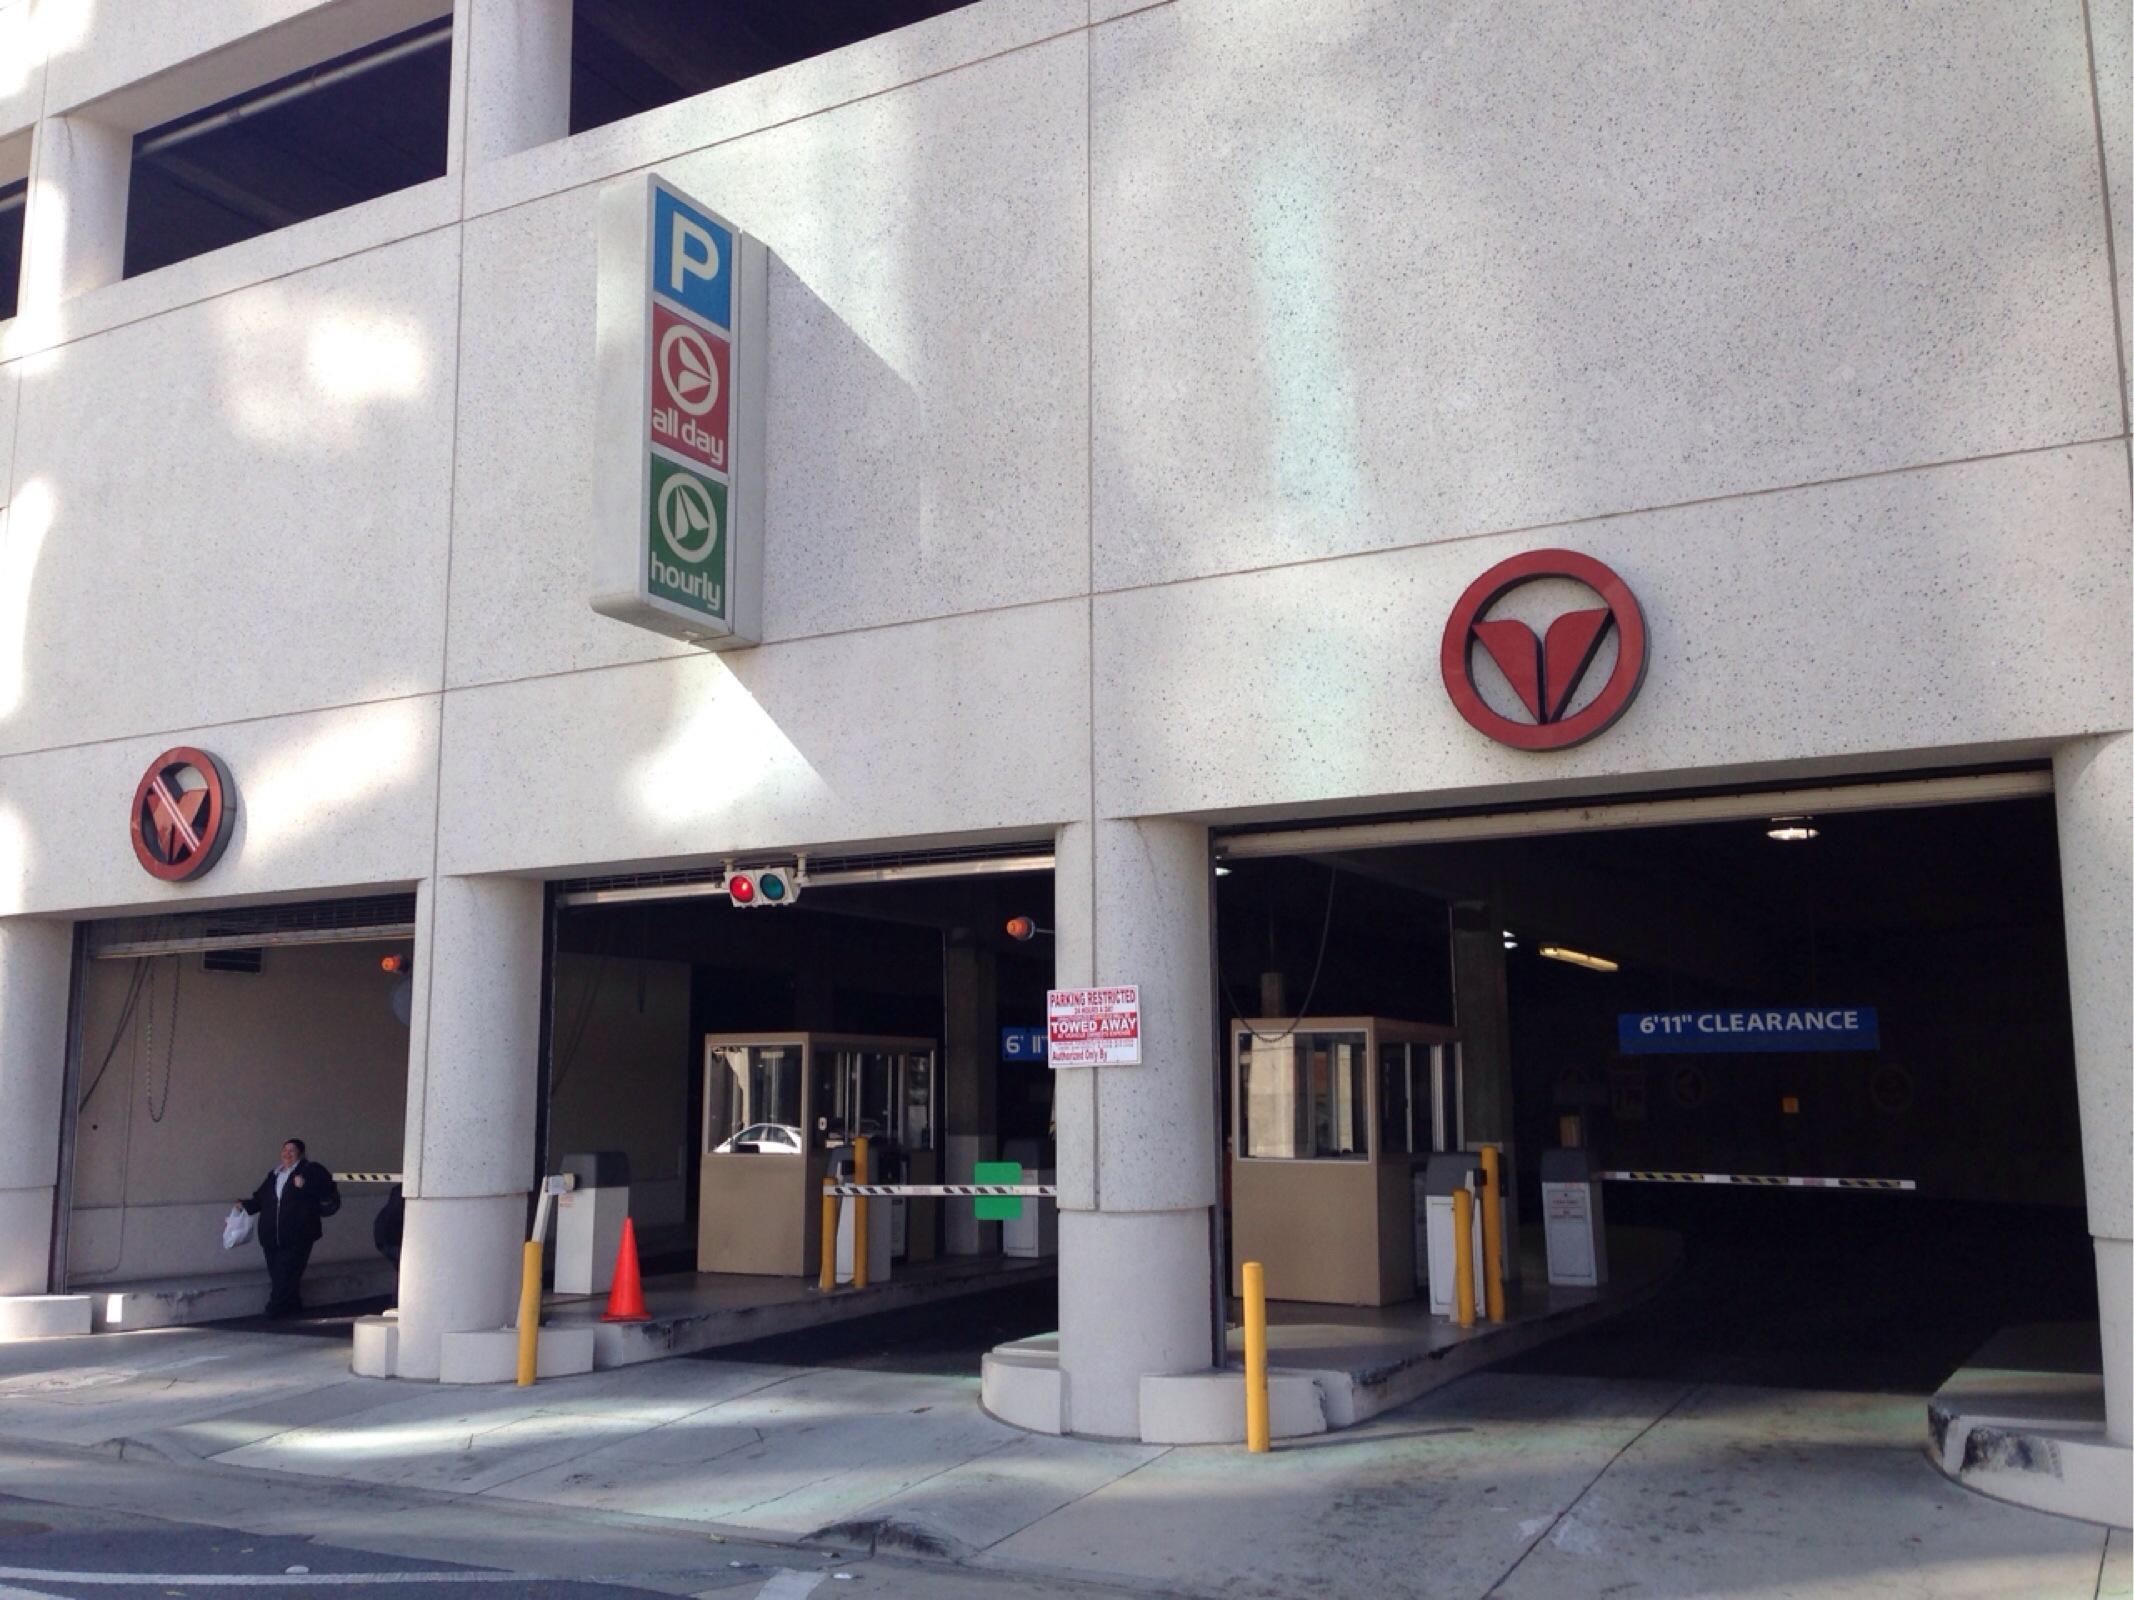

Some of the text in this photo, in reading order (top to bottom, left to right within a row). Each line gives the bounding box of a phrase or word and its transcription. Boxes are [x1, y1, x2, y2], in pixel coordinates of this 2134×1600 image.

[671, 210, 719, 293] P
[652, 407, 724, 465] all day
[651, 551, 720, 611] hourly
[1051, 989, 1136, 1007] PARKING RESTRICTED
[1051, 1018, 1136, 1034] TOWED AWAY
[1639, 1010, 1859, 1034] 6'11" CLEARANCE
[1052, 1047, 1107, 1062] Authorized Only By
